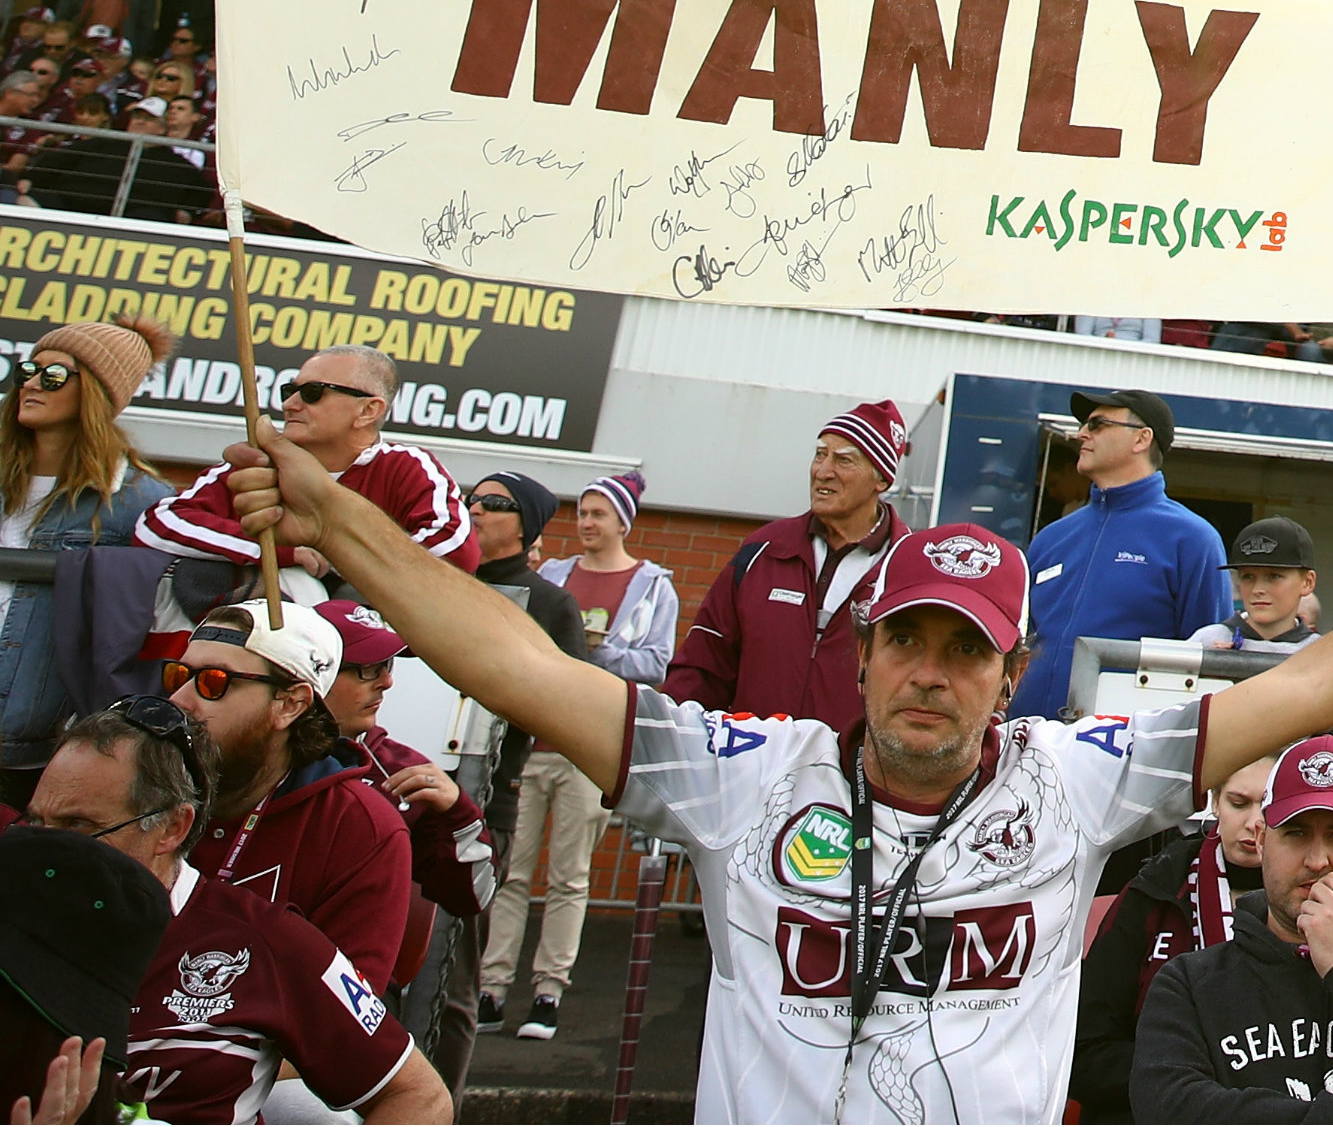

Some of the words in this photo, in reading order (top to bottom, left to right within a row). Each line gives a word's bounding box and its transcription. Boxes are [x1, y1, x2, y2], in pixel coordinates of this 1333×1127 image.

[985, 189, 1264, 258] KASPERSKY
[1259, 211, 1287, 252] lab
[370, 269, 576, 331] ROOFING
[248, 301, 482, 367] COMPANY
[805, 813, 850, 853] NRL
[858, 884, 867, 901] 2017
[858, 901, 866, 914] NRL
[857, 914, 866, 974] PLAYER/OFFICIAL
[873, 959, 884, 978] 2017
[883, 887, 907, 945] PLAYER/OFFICIAL
[162, 995, 235, 1010] PREMIERS
[833, 1003, 915, 1018] REOURCE
[918, 996, 1022, 1015] MANAGEMENT
[1220, 1023, 1287, 1072] SEA
